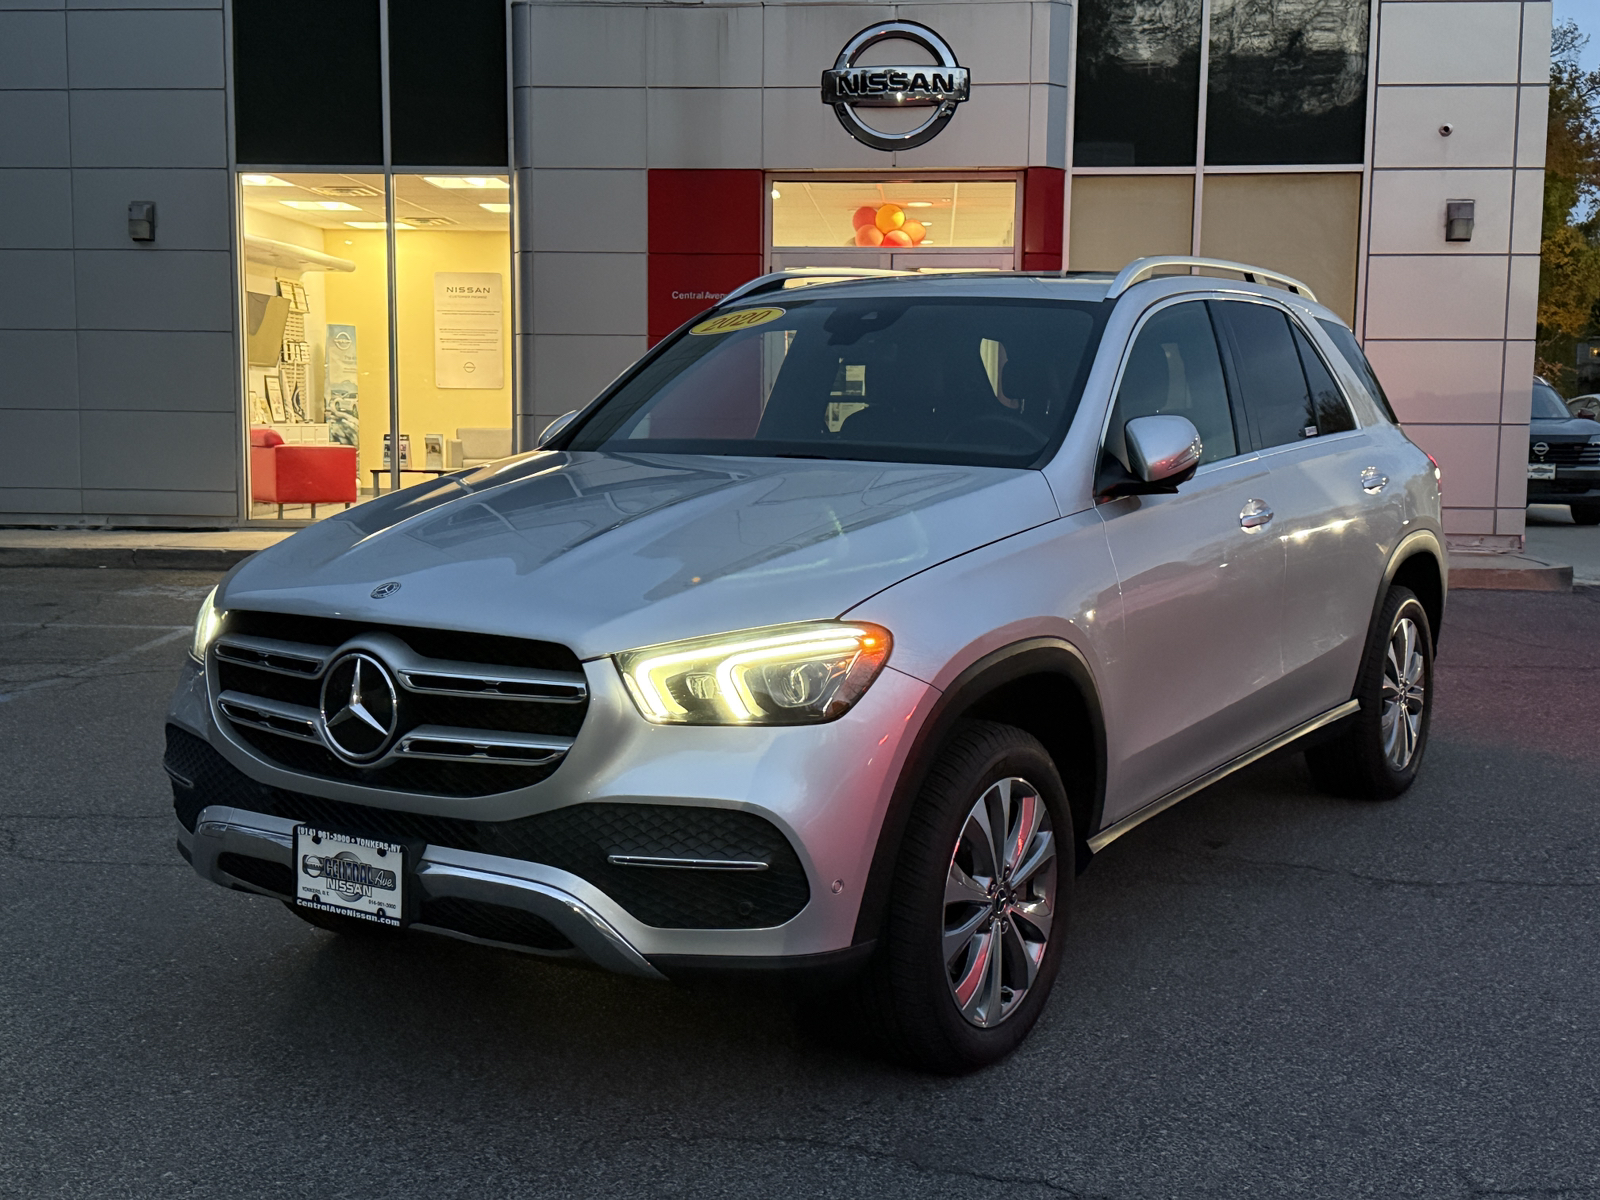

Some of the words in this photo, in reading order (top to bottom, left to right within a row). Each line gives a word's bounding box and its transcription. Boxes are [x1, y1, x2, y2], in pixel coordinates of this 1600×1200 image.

[836, 73, 954, 96] NISSAN
[446, 286, 491, 294] NISSAN
[671, 290, 704, 300] Central
[700, 309, 773, 333] 2020
[324, 857, 374, 884] CENTRAL
[374, 870, 394, 888] Ave.
[326, 878, 373, 898] NISSAN
[296, 898, 400, 927] CentralAveNissan.com
